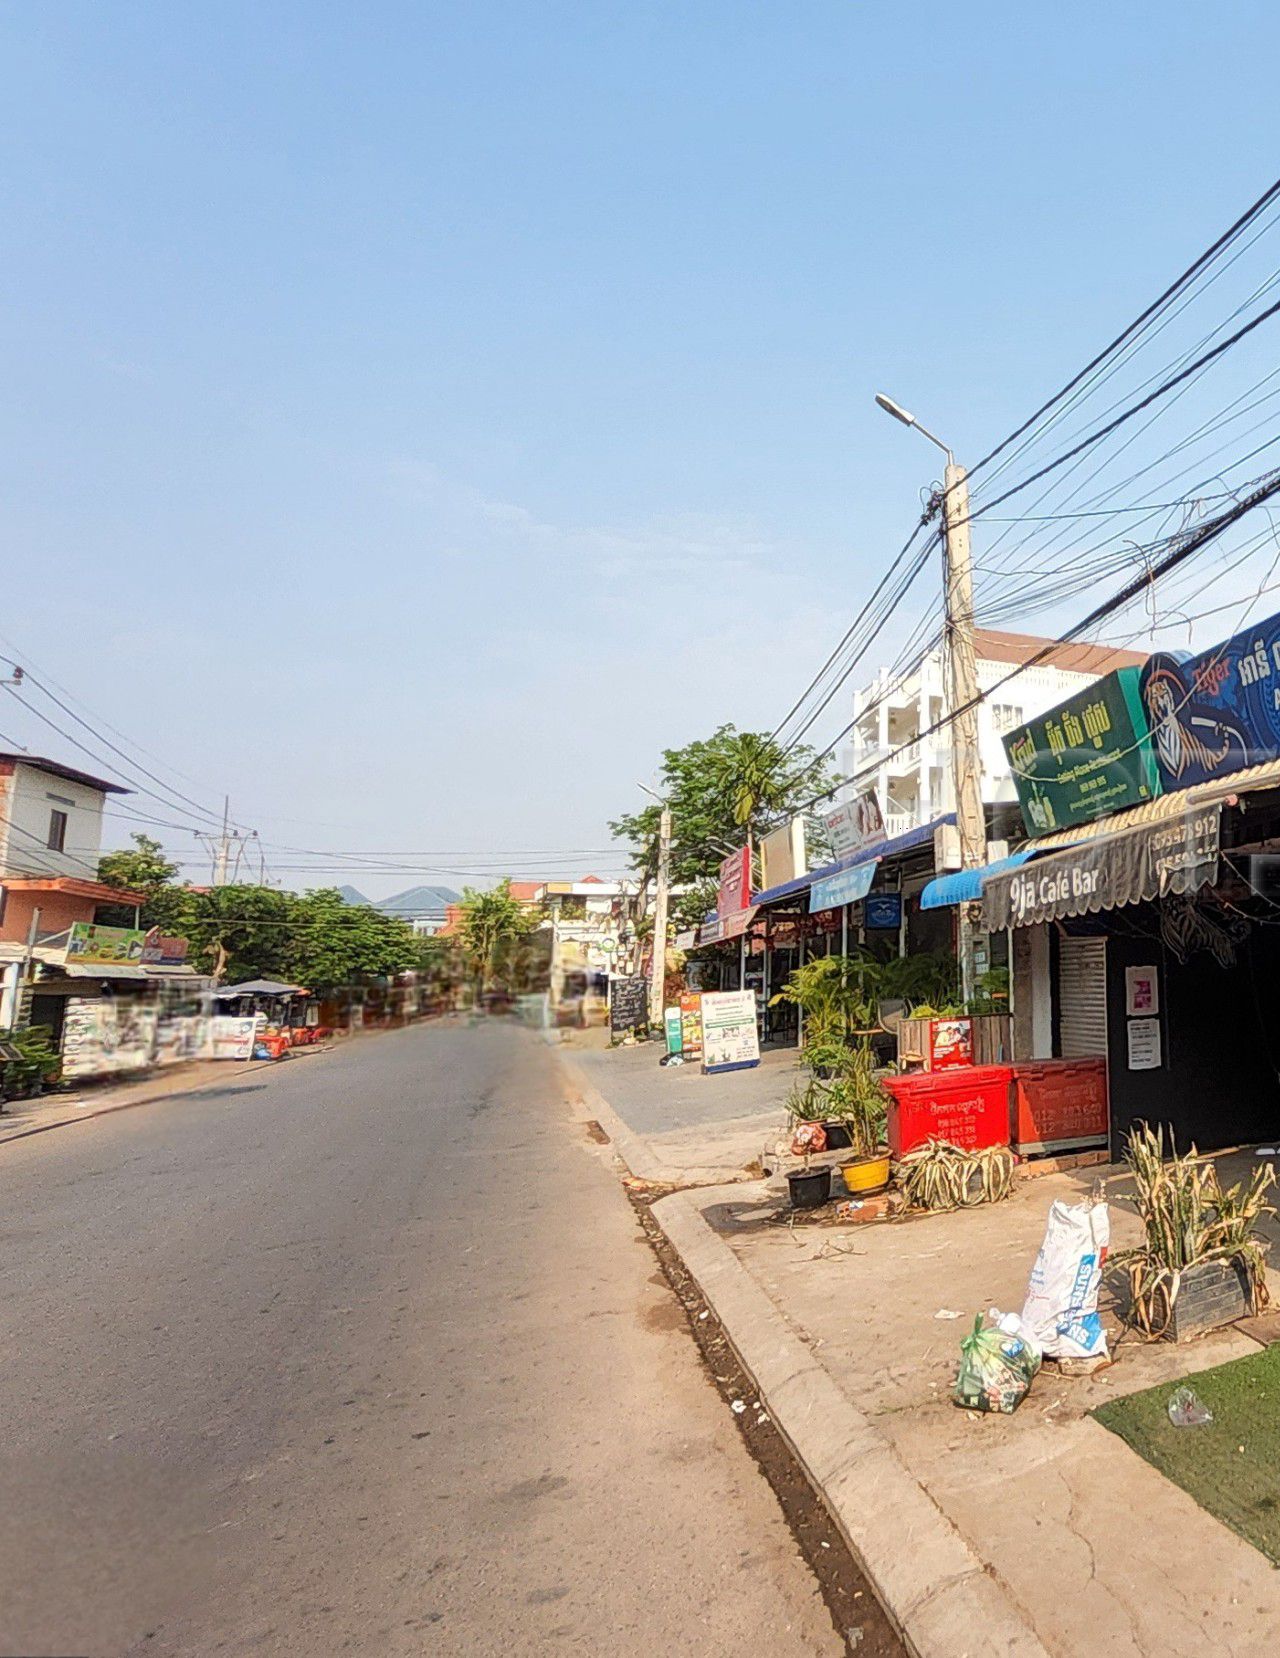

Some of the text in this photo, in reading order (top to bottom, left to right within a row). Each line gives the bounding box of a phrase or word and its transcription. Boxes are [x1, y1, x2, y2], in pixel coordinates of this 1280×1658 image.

[1192, 656, 1231, 697] Tiger
[1010, 866, 1099, 921] 9ja Café Bar
